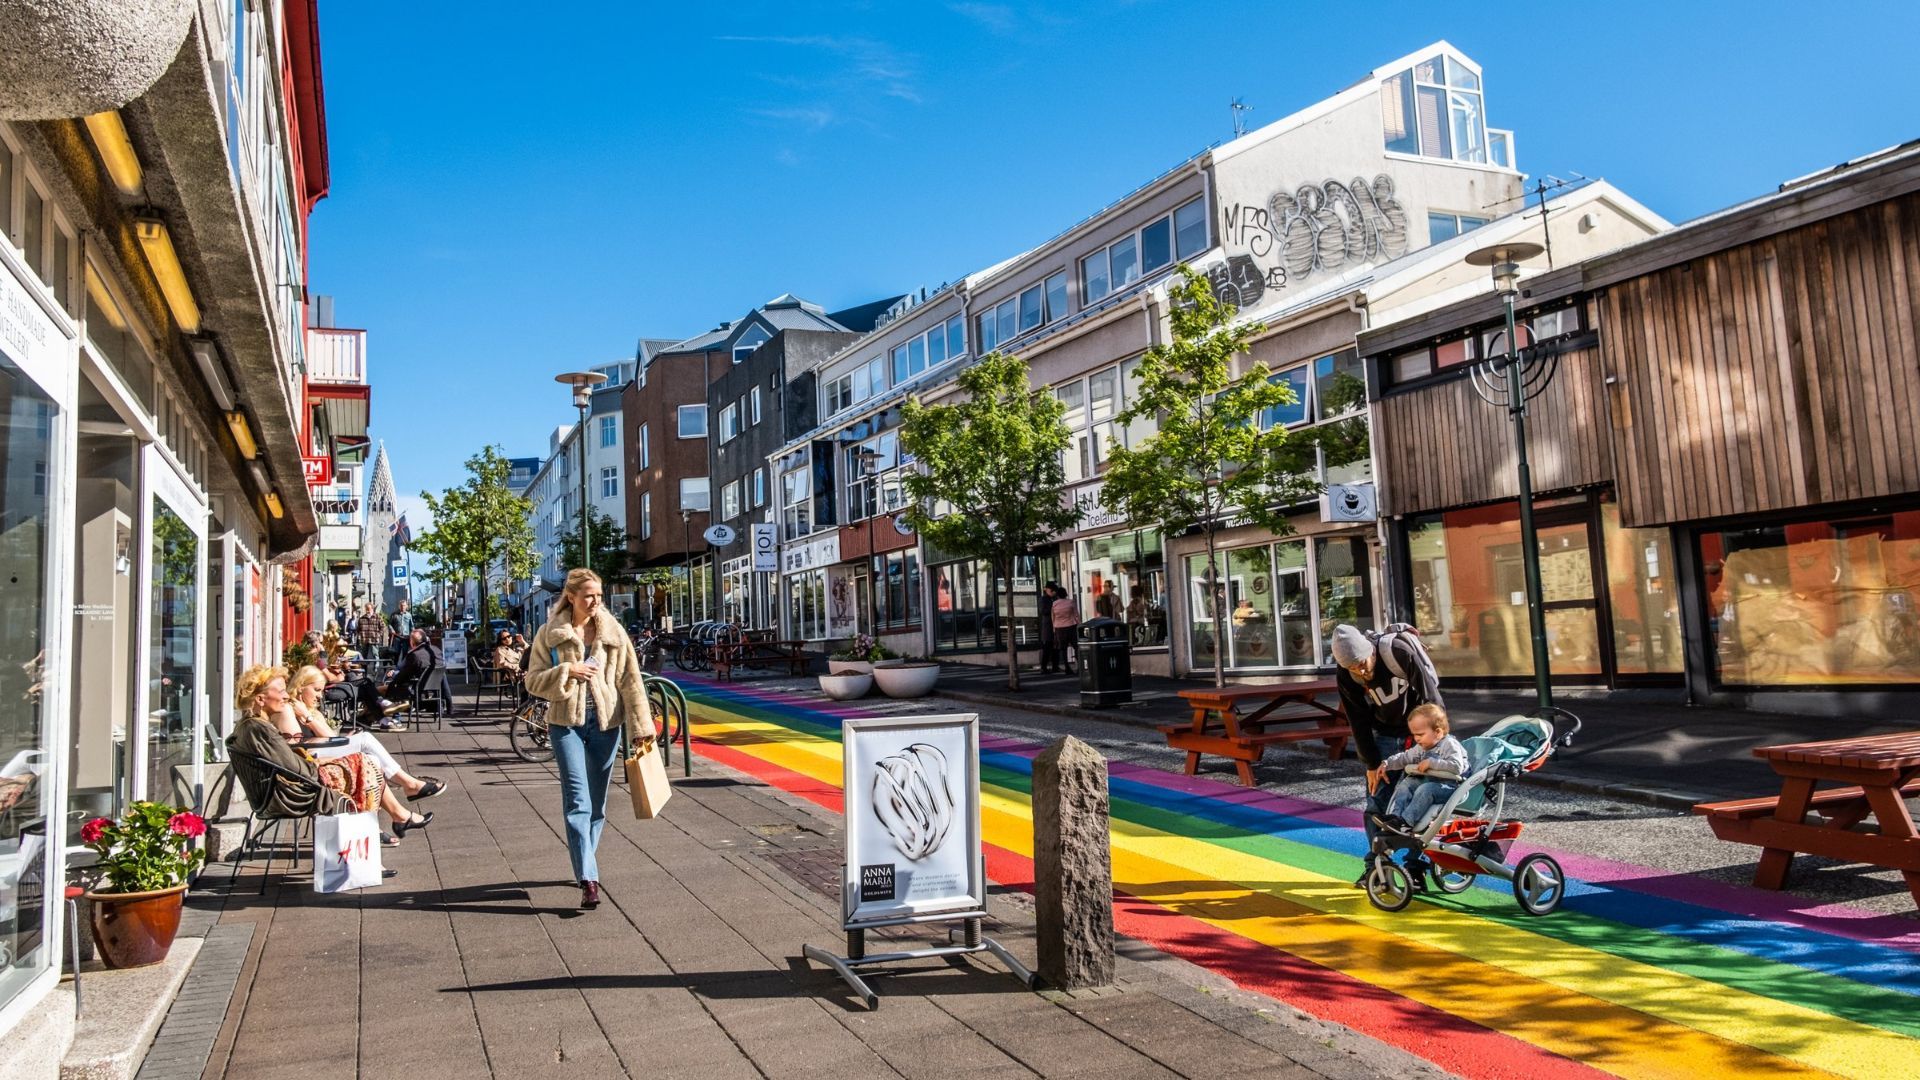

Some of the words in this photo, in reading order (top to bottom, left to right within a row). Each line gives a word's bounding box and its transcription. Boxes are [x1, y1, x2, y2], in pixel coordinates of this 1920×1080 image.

[302, 461, 323, 473] TM
[314, 499, 357, 514] OKKA
[396, 567, 404, 576] P
[1368, 676, 1409, 707] ILA
[864, 867, 892, 878] ANNA
[864, 877, 892, 887] MARIA
